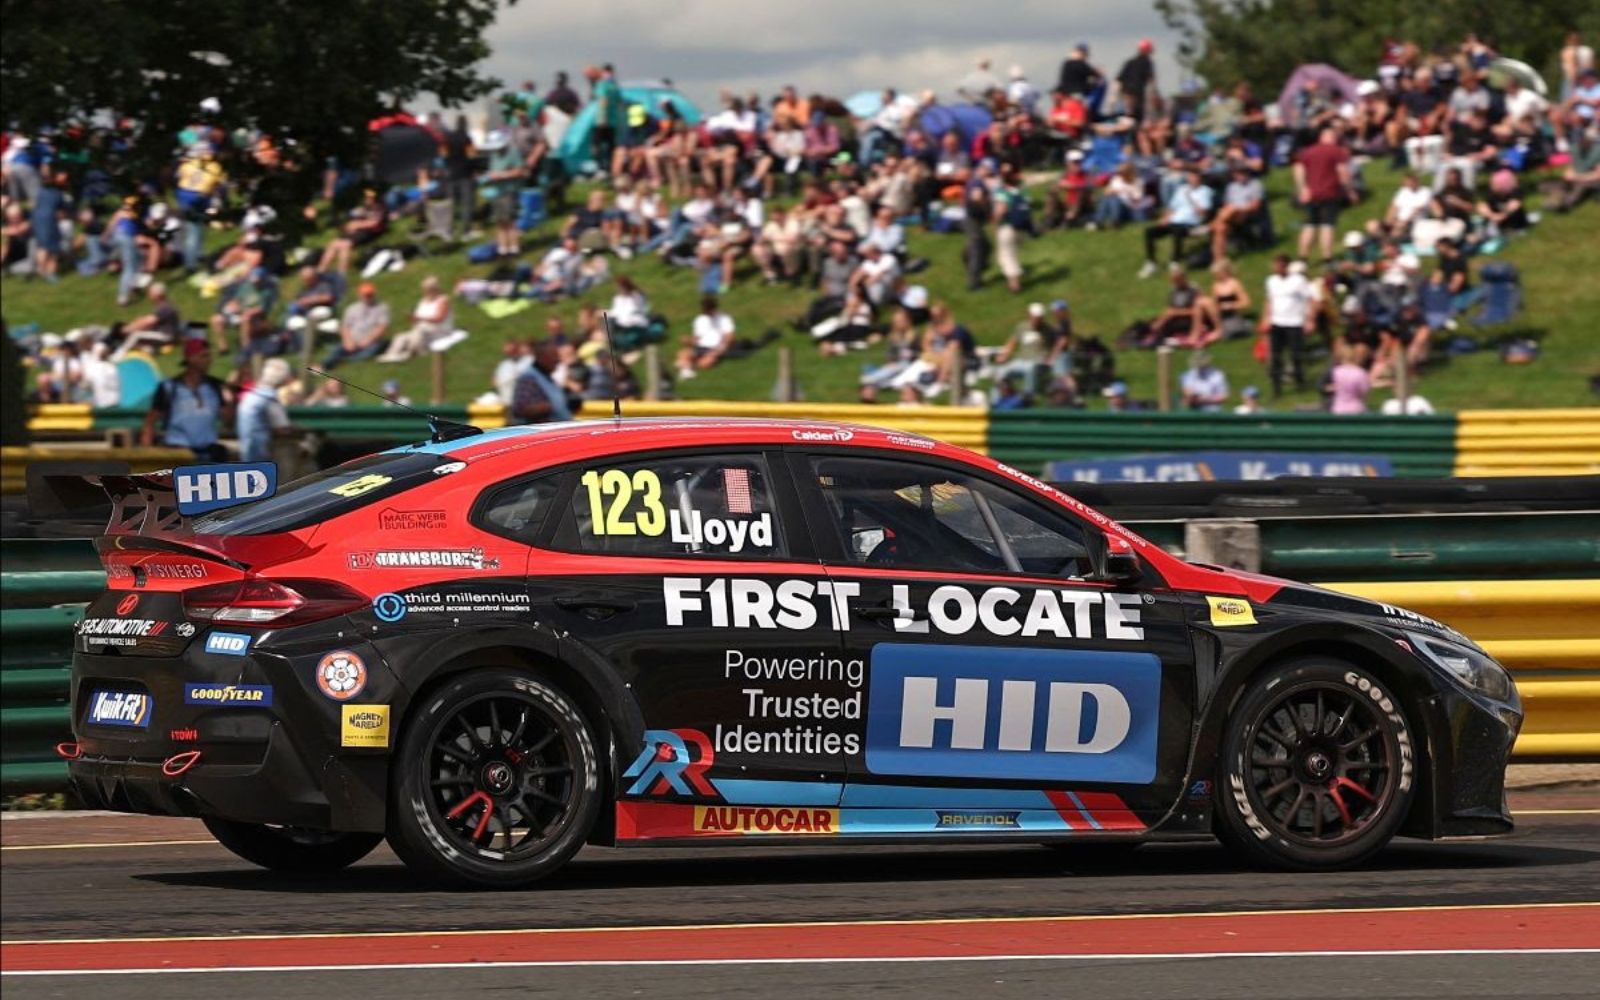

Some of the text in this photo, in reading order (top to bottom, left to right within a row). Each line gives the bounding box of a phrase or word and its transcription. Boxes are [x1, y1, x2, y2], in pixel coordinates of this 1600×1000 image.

[178, 470, 268, 503] HID
[384, 512, 446, 522] MARC WEBB
[581, 469, 667, 537] 123
[384, 520, 434, 530] BUILDING
[669, 509, 773, 553] Lloyd
[405, 592, 530, 603] third millennium
[408, 604, 444, 612] advanced
[473, 604, 500, 612] control
[502, 604, 530, 612] readers
[893, 584, 1145, 641] LOCATE
[209, 635, 245, 651] HID
[725, 650, 864, 688] Powering
[742, 689, 861, 720] Trusted
[900, 676, 1131, 754] HID
[715, 724, 860, 755] Identities
[701, 808, 832, 832] AUTOCAR
[941, 814, 1014, 826] RAVENOL
